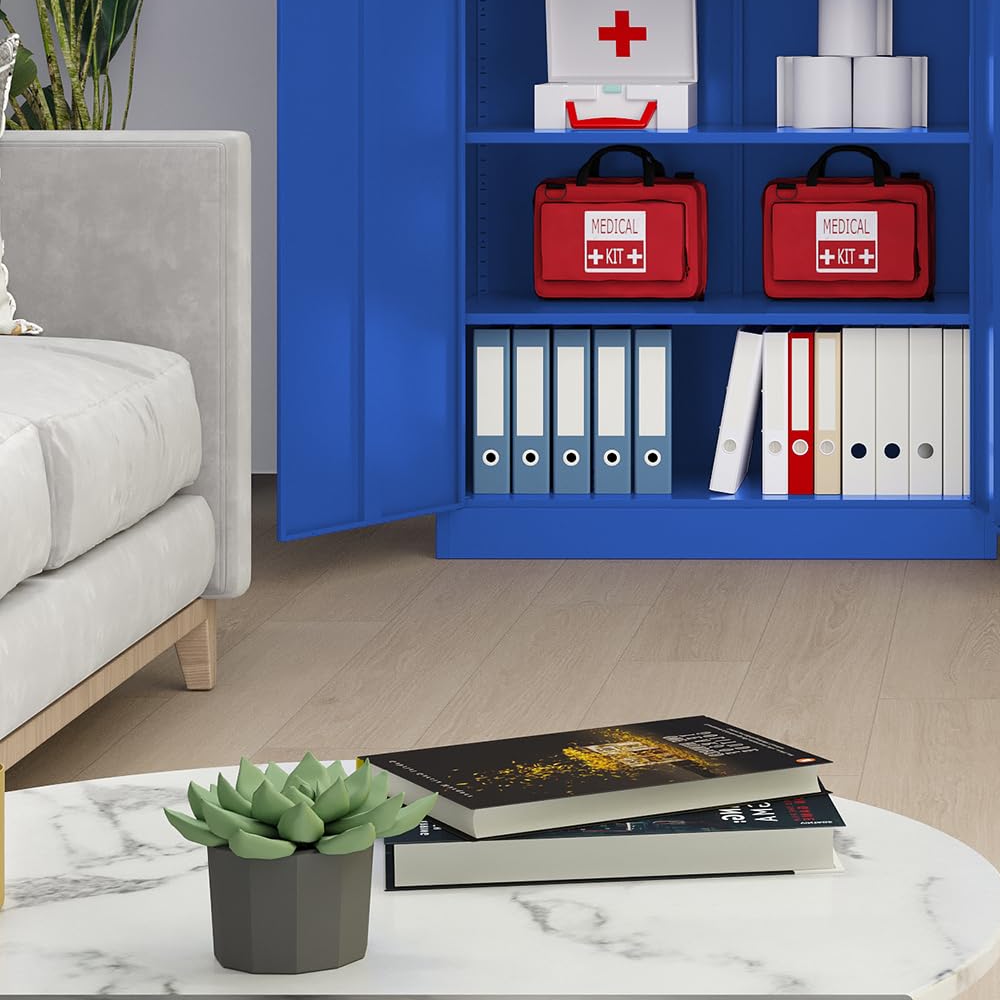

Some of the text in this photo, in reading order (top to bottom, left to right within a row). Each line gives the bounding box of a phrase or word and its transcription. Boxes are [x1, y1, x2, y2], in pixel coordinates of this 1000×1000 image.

[592, 218, 638, 234] MEDICAL
[823, 218, 870, 234] MEDICAL
[606, 248, 624, 265] KIT
[838, 248, 856, 265] KIT
